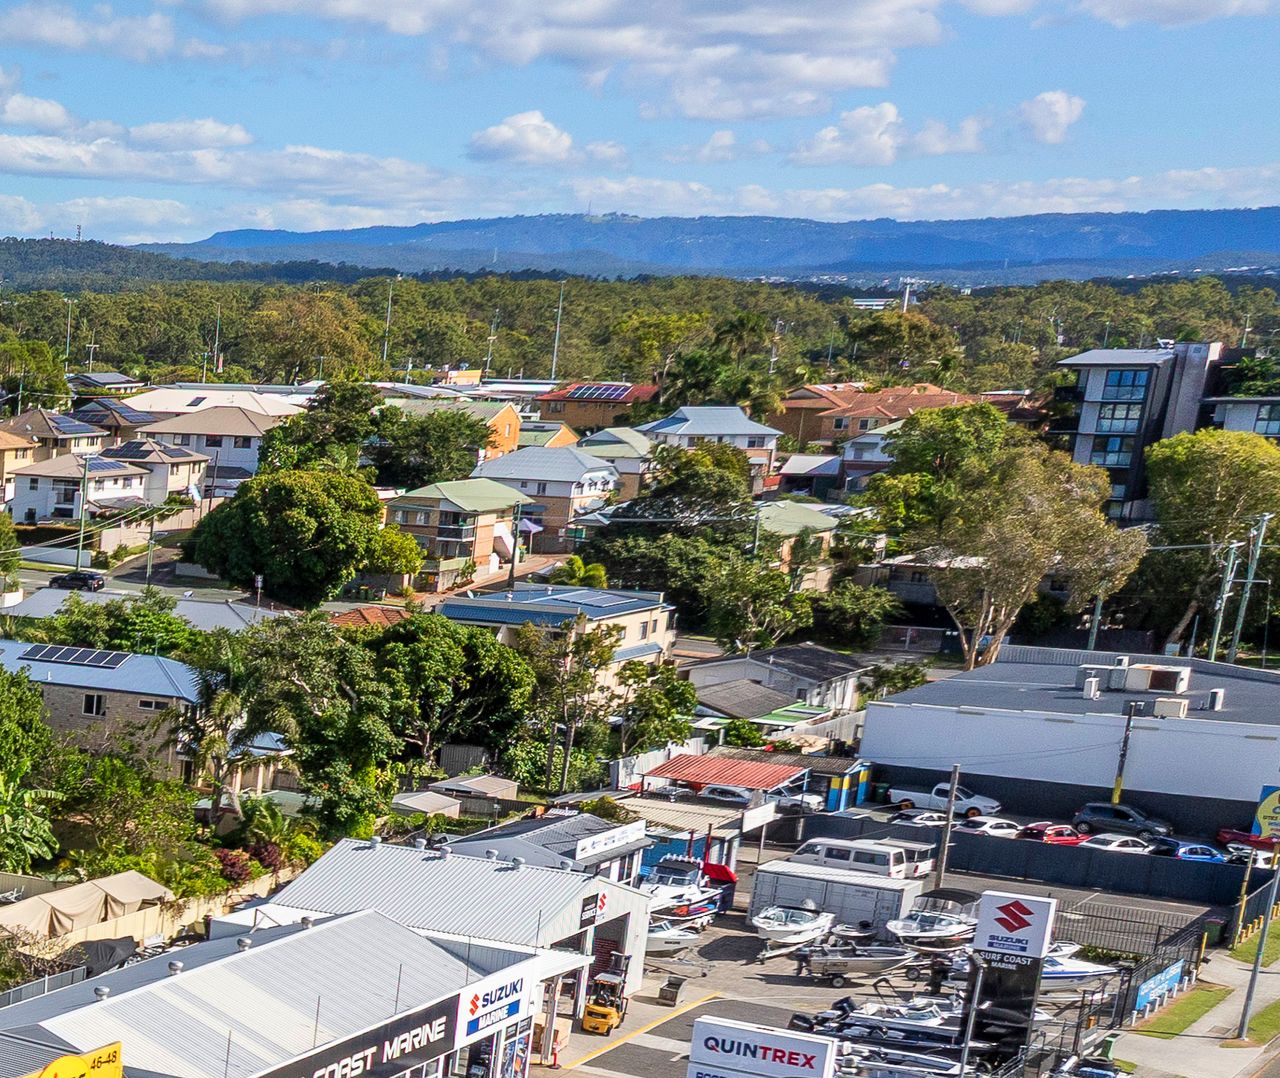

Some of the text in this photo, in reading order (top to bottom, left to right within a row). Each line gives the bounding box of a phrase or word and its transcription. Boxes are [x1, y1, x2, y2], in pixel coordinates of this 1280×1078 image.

[989, 934, 1028, 945] SUZUKI
[980, 951, 1032, 966] SURF COAST
[482, 977, 523, 1008] SUZUKI
[480, 1006, 509, 1027] MARINE
[382, 1016, 446, 1063] MARINE
[90, 1050, 117, 1070] 46-48
[704, 1036, 817, 1069] QUINTREX
